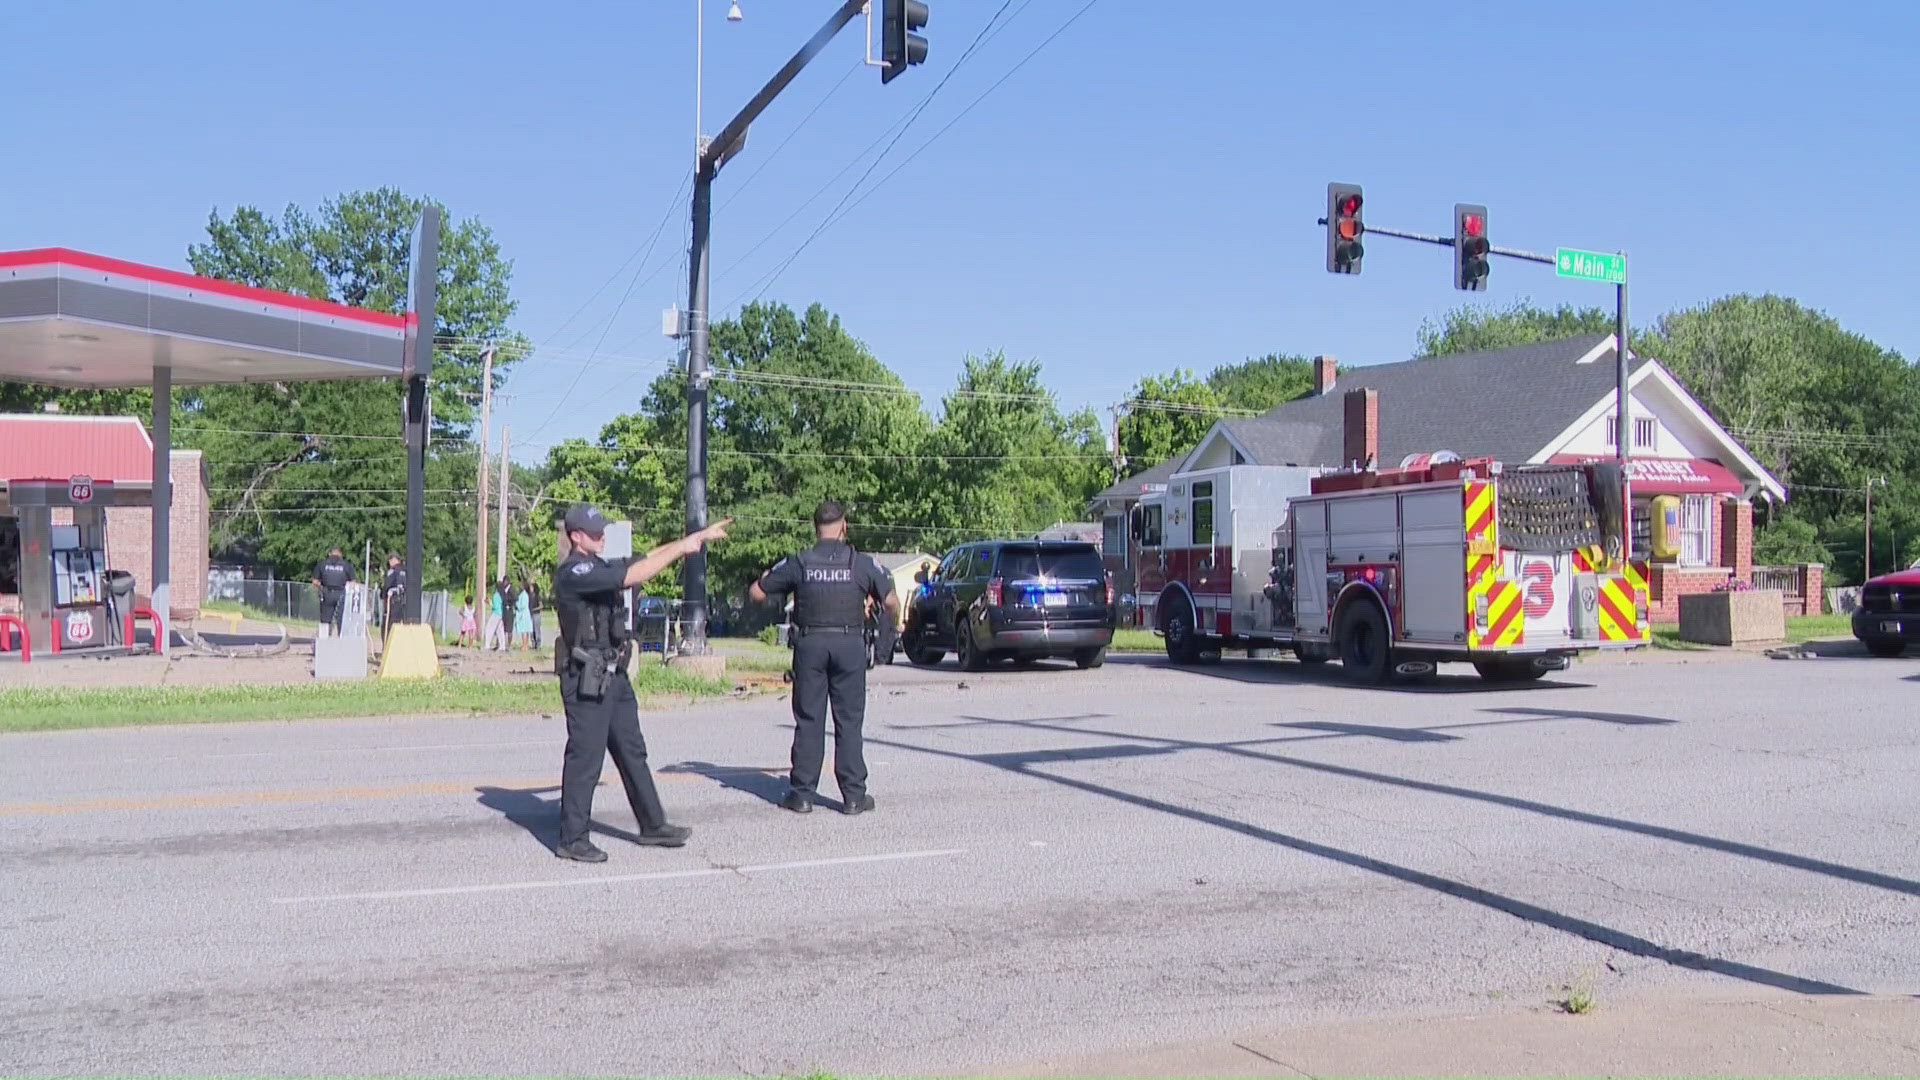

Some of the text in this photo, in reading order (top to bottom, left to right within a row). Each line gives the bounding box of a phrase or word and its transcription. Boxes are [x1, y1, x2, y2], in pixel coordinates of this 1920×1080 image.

[1573, 253, 1604, 278] Main
[1645, 472, 1682, 484] Beauty
[73, 485, 89, 498] 66
[806, 568, 851, 582] POLICE
[1521, 559, 1555, 620] 3
[72, 623, 88, 637] 66
